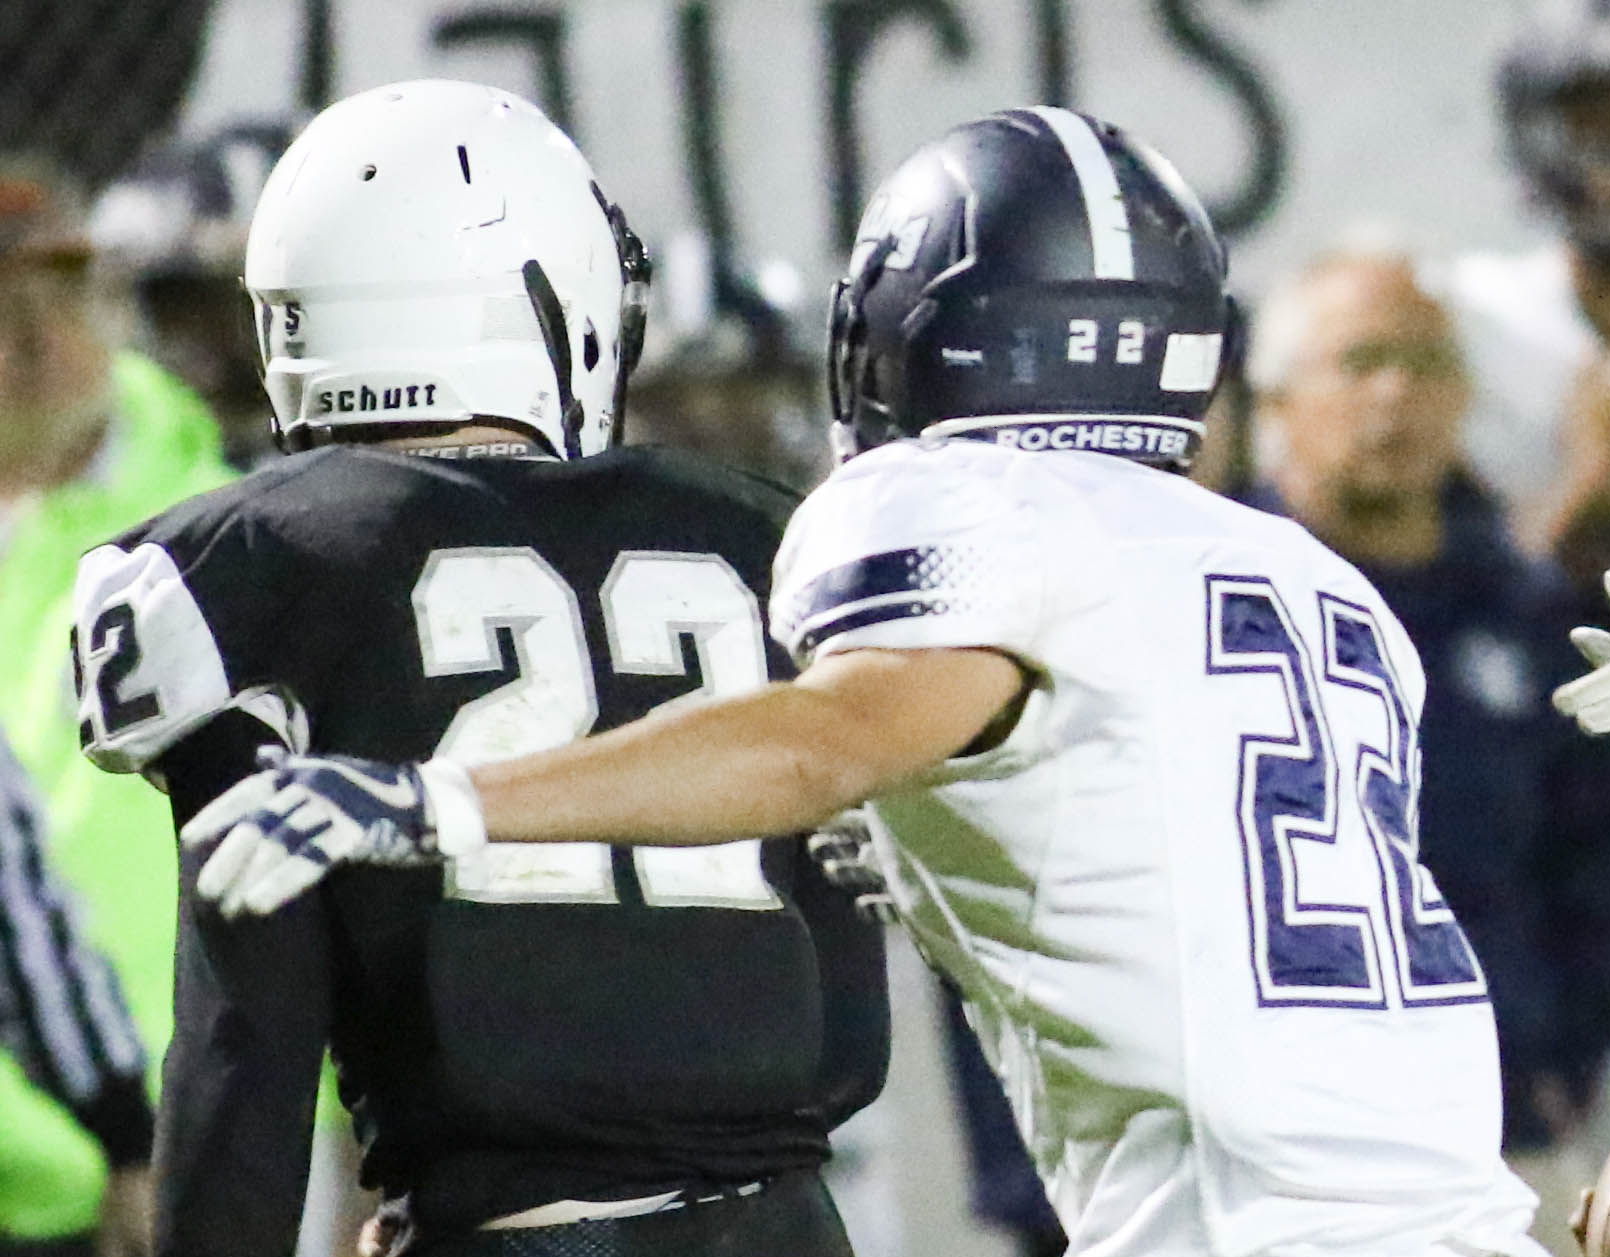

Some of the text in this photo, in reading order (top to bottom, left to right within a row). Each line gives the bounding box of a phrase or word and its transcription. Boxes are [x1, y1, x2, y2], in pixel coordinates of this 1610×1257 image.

[1067, 318, 1146, 364] 22
[319, 384, 437, 413] schutt
[996, 423, 1191, 455] ROCHESTER
[69, 601, 165, 750] 2
[410, 545, 785, 912] 22
[1203, 573, 1491, 1011] 22
